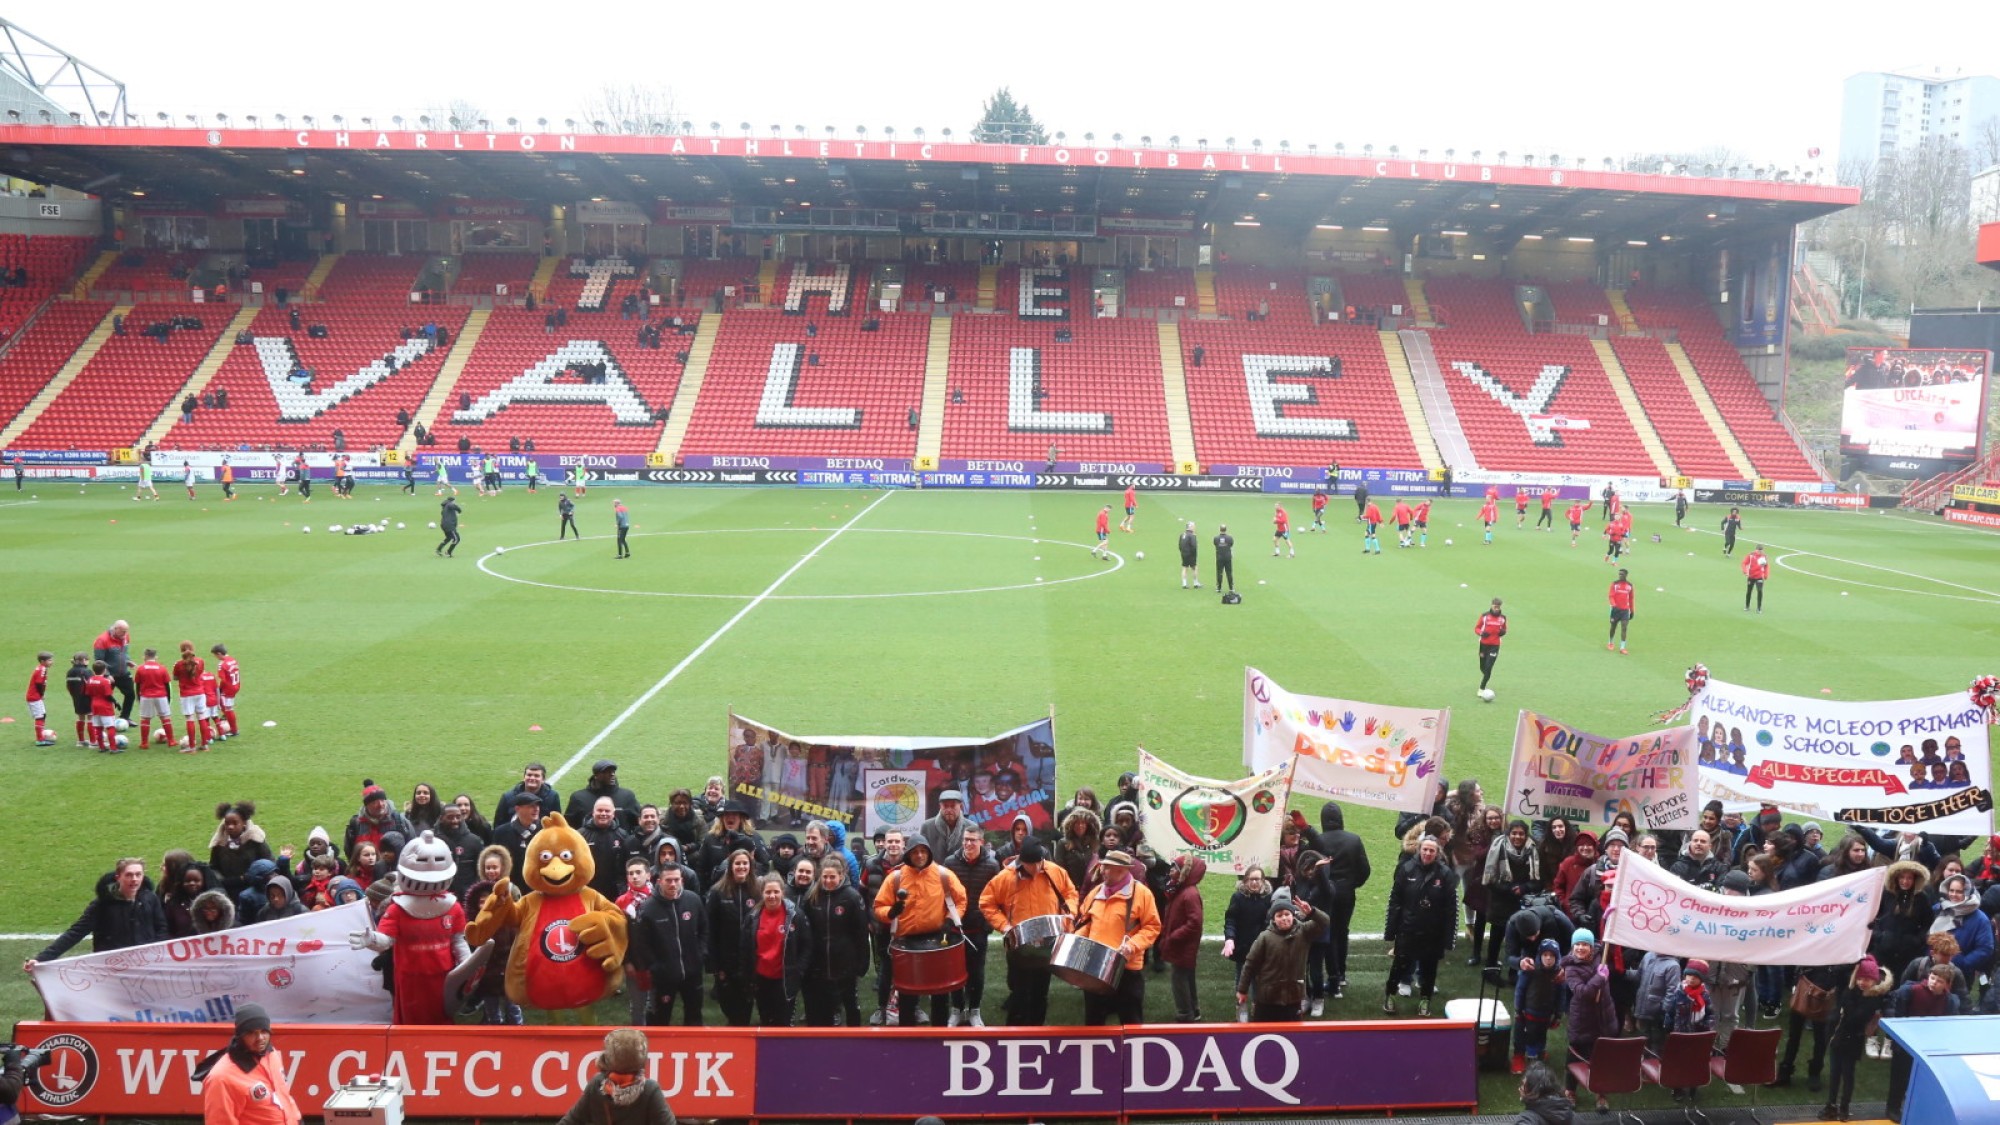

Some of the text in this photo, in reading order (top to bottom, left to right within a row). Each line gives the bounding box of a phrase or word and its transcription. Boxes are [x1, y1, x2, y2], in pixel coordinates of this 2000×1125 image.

[297, 131, 1493, 182] CHARLTON ATHLETIC FOOTBALL CLUB
[40, 205, 59, 216] FSE
[253, 336, 1569, 446] VALLEY
[559, 455, 617, 468] BETDAQ
[712, 455, 770, 468] BETDAQ
[826, 458, 884, 471] BETDAQ
[967, 460, 1024, 473] BETDAQ
[1079, 462, 1136, 475] BETDAQ
[249, 469, 296, 480] BETQ
[604, 471, 639, 482] hummel
[720, 471, 755, 482] hummel
[879, 473, 911, 484] ITRM
[934, 473, 965, 485] ITRM
[1000, 474, 1031, 485] ITRM
[1238, 465, 1293, 479] BETDAQ
[1073, 475, 1108, 486] hummel
[1187, 478, 1222, 488] hummel
[1516, 486, 1560, 497] ETDQ
[1724, 492, 1749, 501] COME
[1750, 493, 1762, 501] TO
[1955, 485, 1998, 500] DATA CARS
[1701, 694, 1987, 737] ALEXANDER MCLEOD PRIMARY
[1534, 719, 1673, 767] YOUTH DEAF
[1783, 734, 1861, 757] SCHOOL
[1635, 748, 1690, 768] STATION
[1144, 770, 1183, 790] SPECIAL
[1524, 754, 1686, 792] ALL TOGETHER
[1762, 762, 1890, 785] ALL SPECIAL
[1548, 783, 1584, 798] VOTES
[736, 781, 854, 826] ALL DIFFERENT
[967, 788, 1050, 825] ALL SPECIAL
[1643, 791, 1688, 818] Everyone
[1841, 788, 1983, 825] ALL TOGETHER
[1646, 804, 1690, 829] Matters
[1679, 897, 1750, 919] Charlton
[1787, 902, 1850, 918] Library
[1694, 920, 1796, 942] All Together
[167, 934, 287, 962] Orchard
[116, 1047, 736, 1100] WW.CAFC.COUK
[942, 1033, 1302, 1105] BETDAQ
[39, 1090, 80, 1103] ATHLETIC
